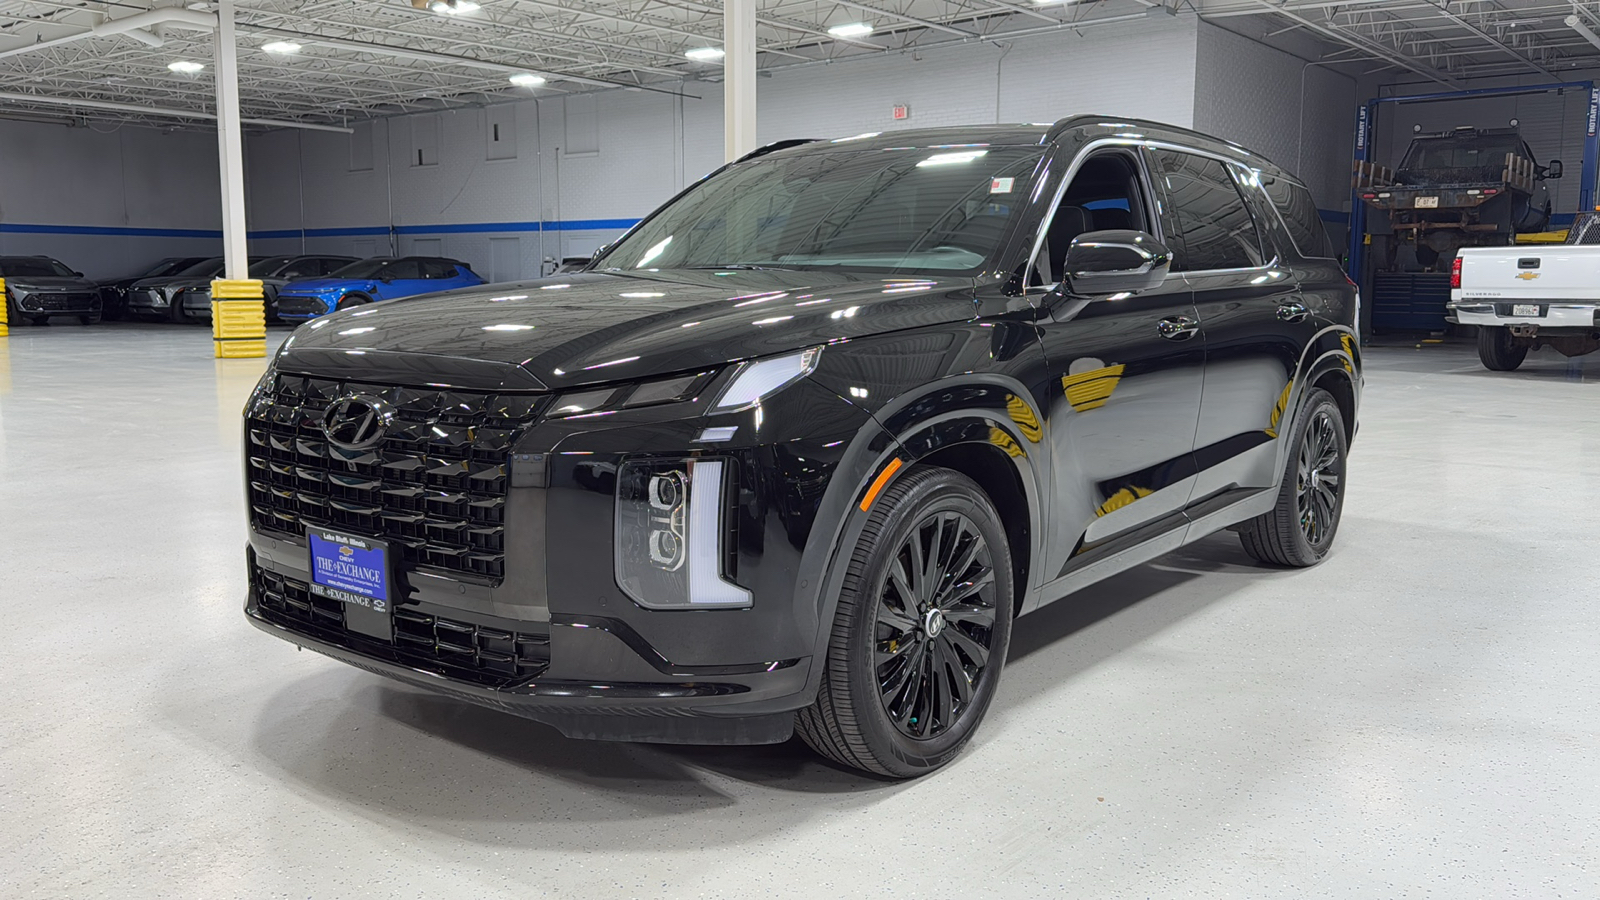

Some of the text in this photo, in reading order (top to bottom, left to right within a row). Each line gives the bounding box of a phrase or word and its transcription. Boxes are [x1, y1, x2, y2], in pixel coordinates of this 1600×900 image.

[1588, 88, 1599, 132] ROTARY LIFT
[322, 532, 335, 541] Lake
[349, 538, 366, 548] Illinois
[316, 556, 380, 583] THE EXCHANGE
[311, 584, 370, 607] THE EXCHANGE
